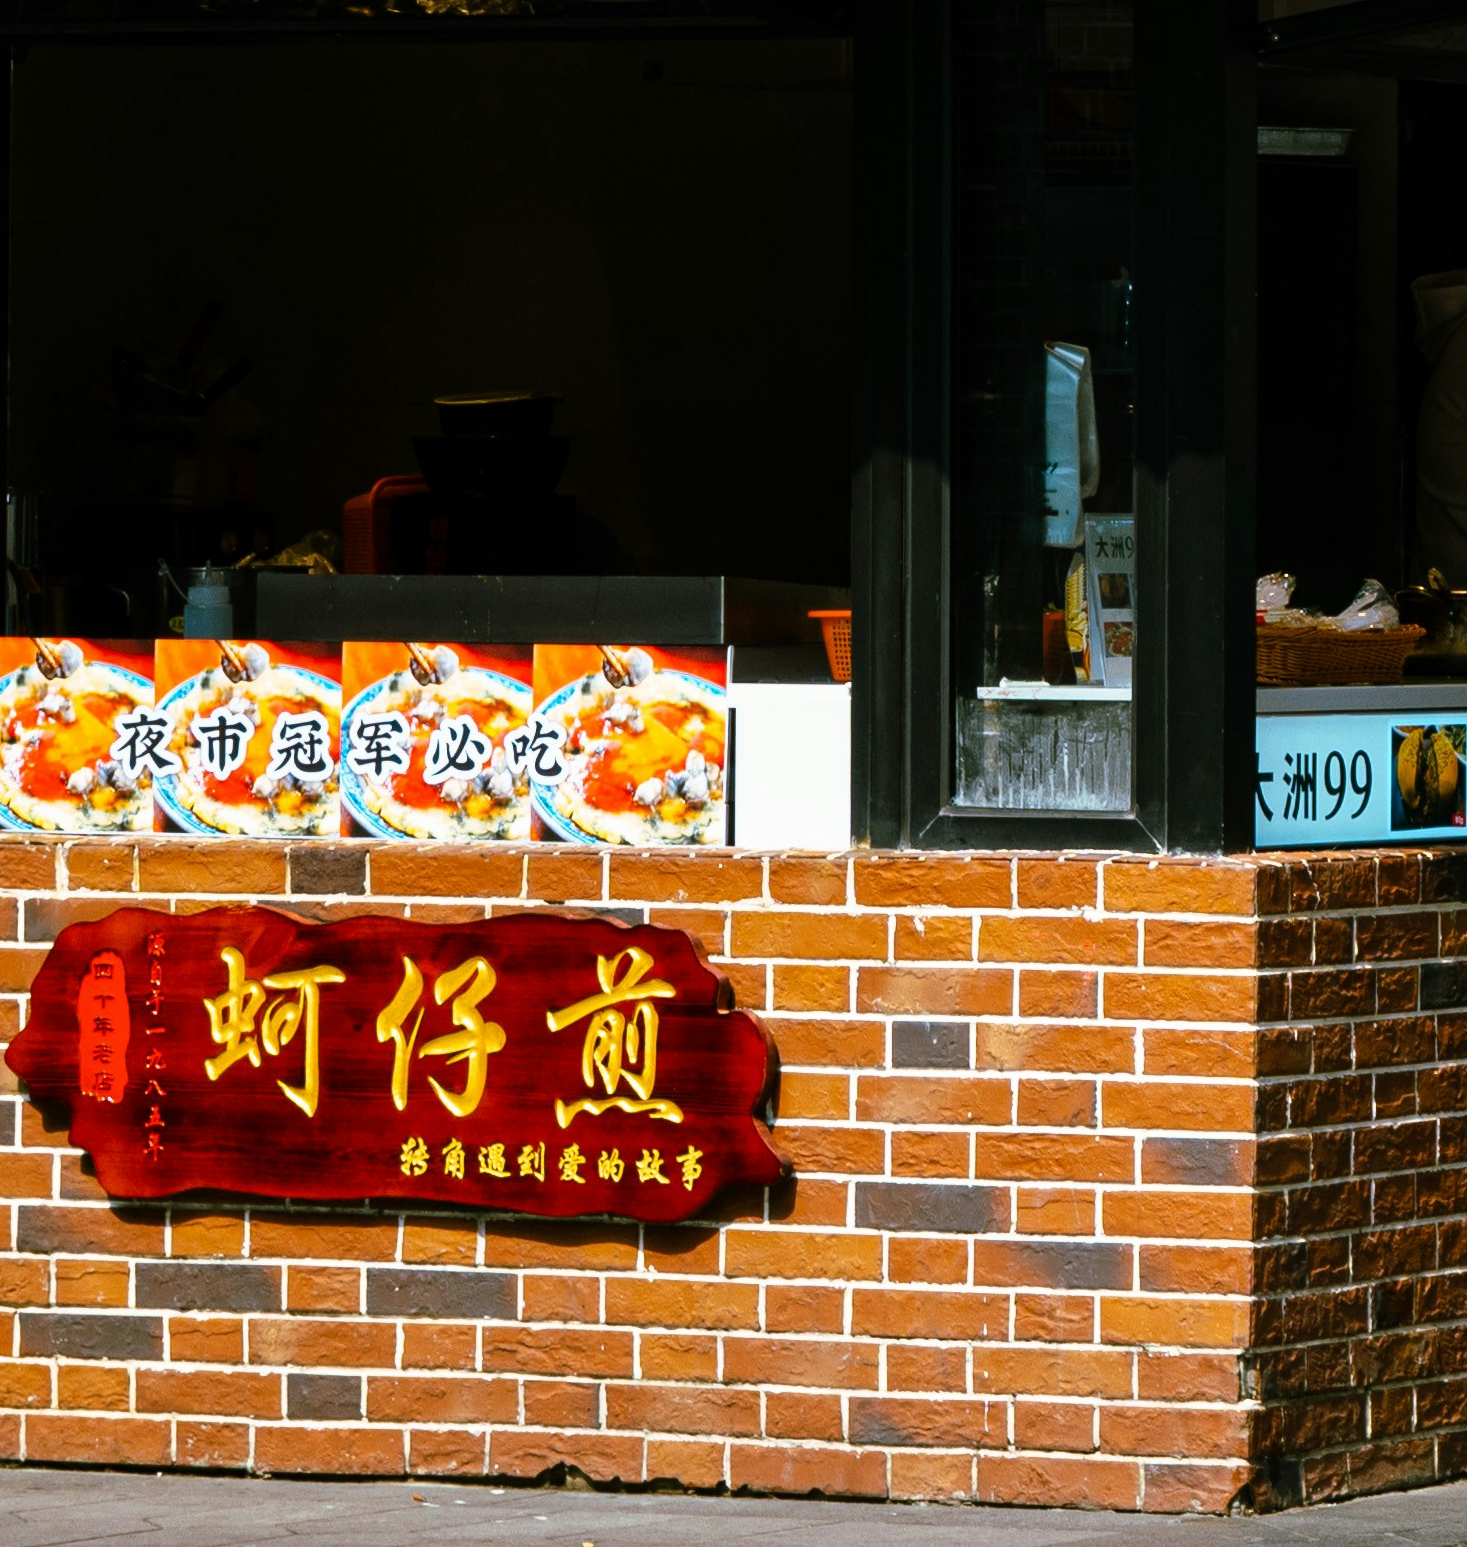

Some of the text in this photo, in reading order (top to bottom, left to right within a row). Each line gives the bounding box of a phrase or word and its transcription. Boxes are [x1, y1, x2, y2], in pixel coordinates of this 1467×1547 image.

[116, 712, 567, 778] 夜市冠军必吃
[93, 963, 116, 1092] 四十年老店
[202, 945, 686, 1131] 蚵仔煎
[400, 1137, 705, 1192] 转角遇到爱的故事
